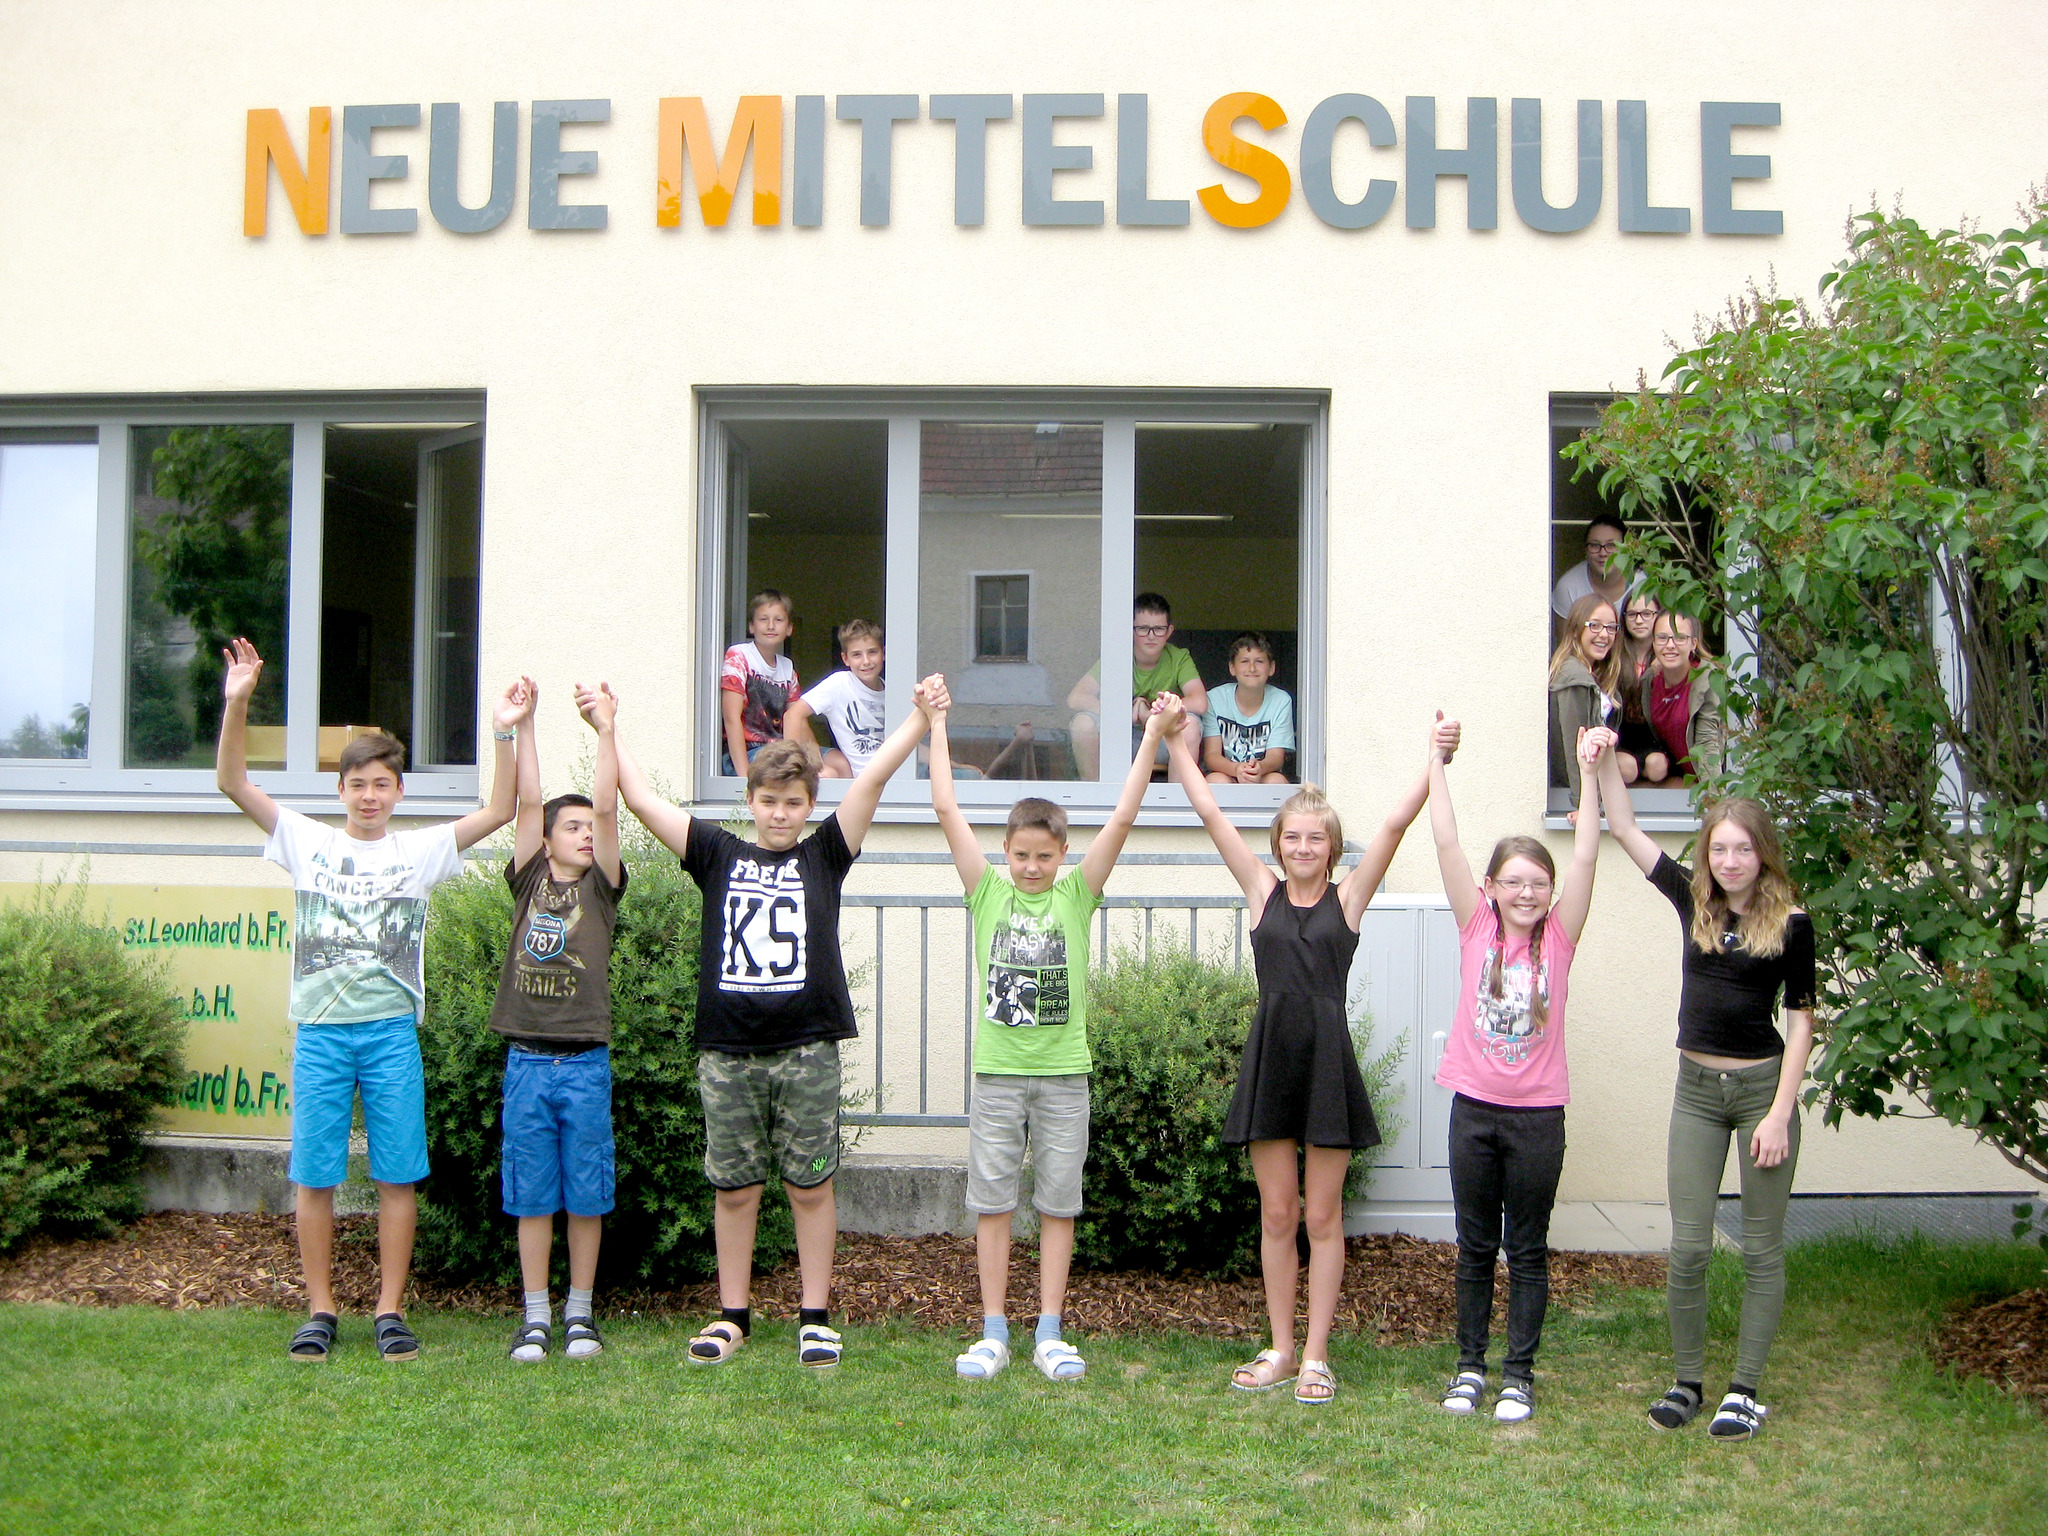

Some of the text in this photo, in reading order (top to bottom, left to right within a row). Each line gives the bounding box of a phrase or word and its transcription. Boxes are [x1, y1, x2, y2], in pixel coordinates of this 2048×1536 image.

[243, 91, 1784, 237] NEUE MITTELSCHULE
[123, 912, 243, 945] St.Leonhard
[247, 910, 292, 949] b.Fr.
[529, 931, 559, 952] 787
[726, 896, 799, 977] KS
[1041, 999, 1068, 1010] BREAK
[233, 1066, 290, 1110] b.Fr.
